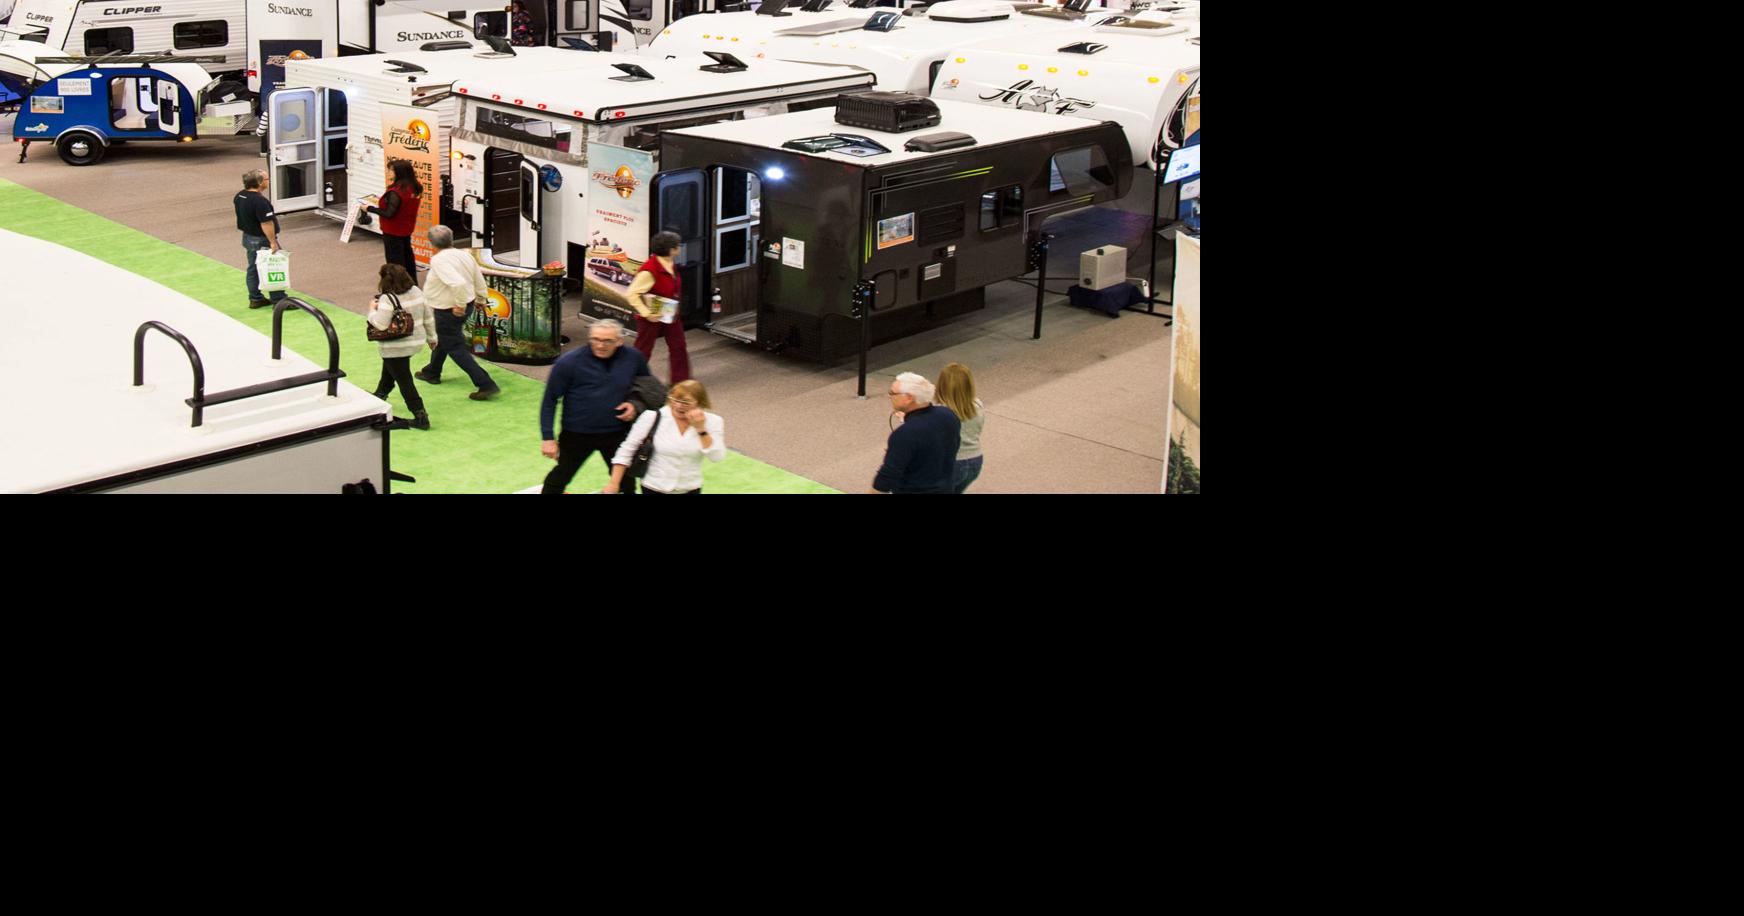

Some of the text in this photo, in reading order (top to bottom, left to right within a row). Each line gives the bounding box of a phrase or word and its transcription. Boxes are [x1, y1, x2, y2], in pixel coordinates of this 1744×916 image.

[103, 6, 162, 16] CLIPPER
[26, 12, 54, 22] CLIPPER
[270, 273, 284, 281] VR
